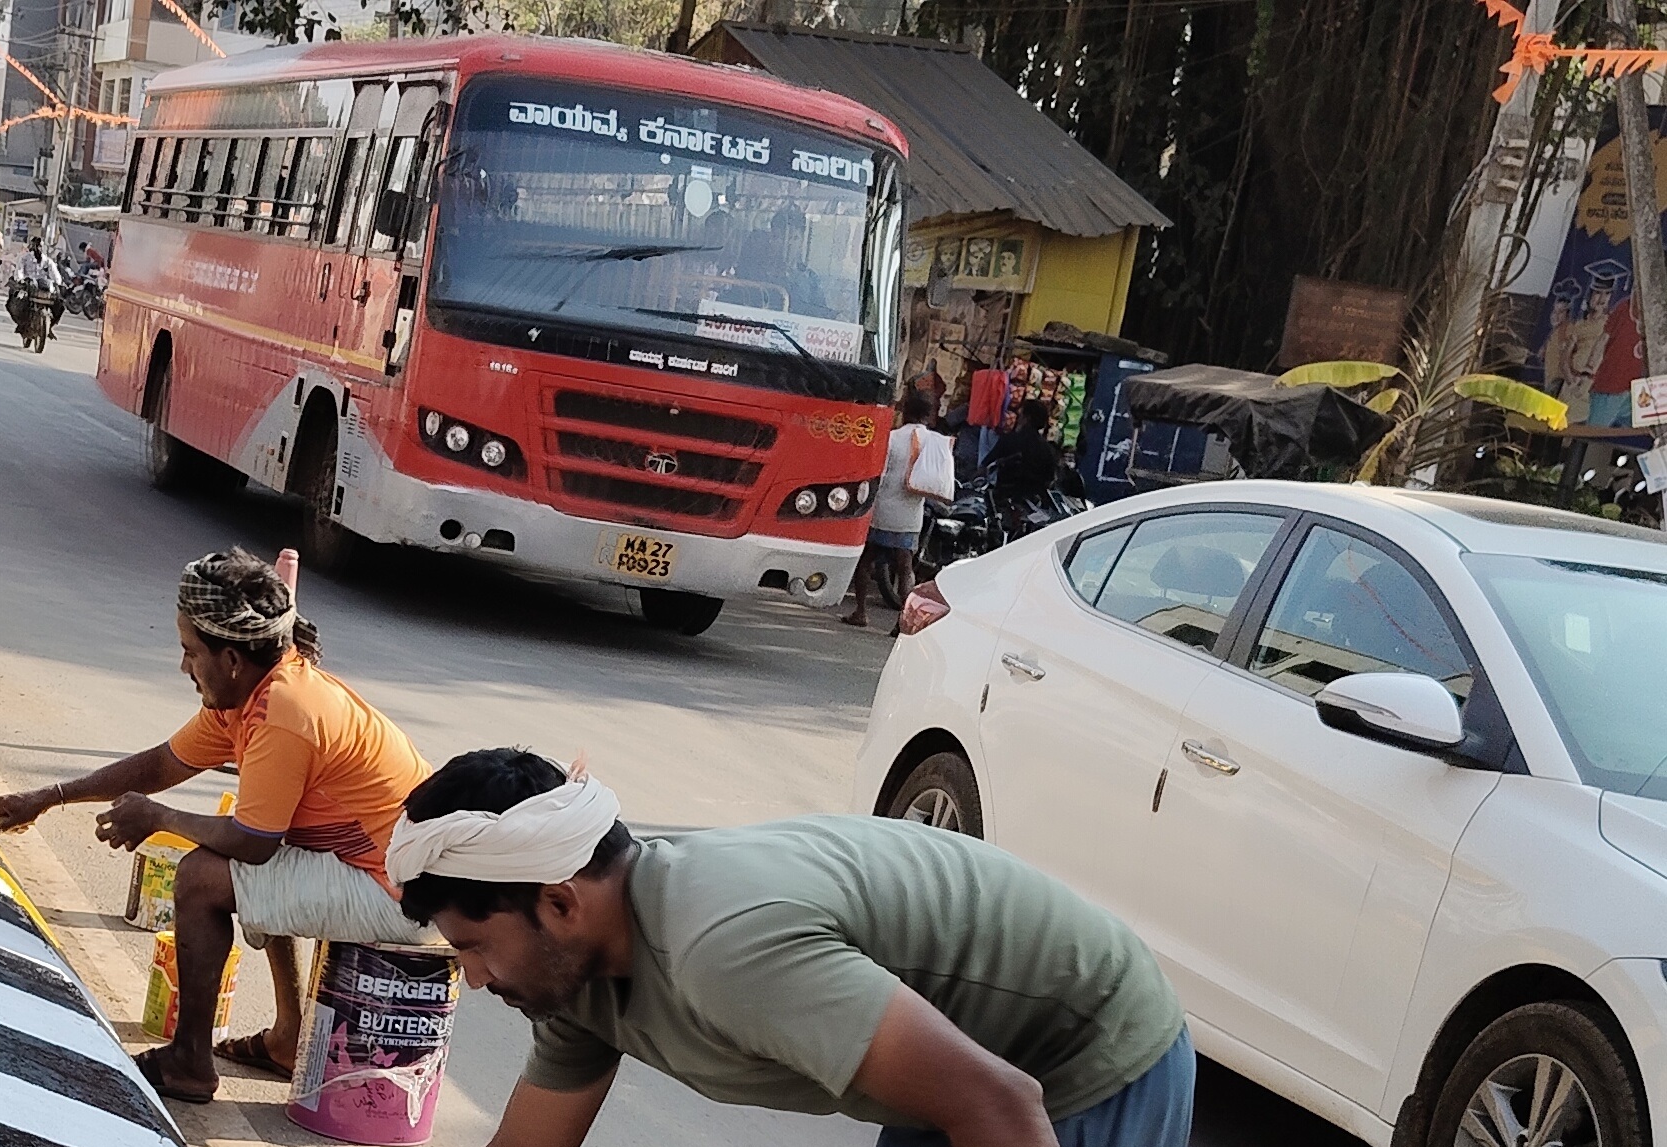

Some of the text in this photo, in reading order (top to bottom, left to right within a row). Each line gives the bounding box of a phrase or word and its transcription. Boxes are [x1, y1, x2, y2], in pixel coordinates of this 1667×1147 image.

[508, 101, 874, 186] ವಾಯವ್ಯ ಕರ್ನಾಟಕ ಸಾರಿಗೆ
[624, 537, 674, 559] KA 27
[356, 973, 447, 1001] BERGER
